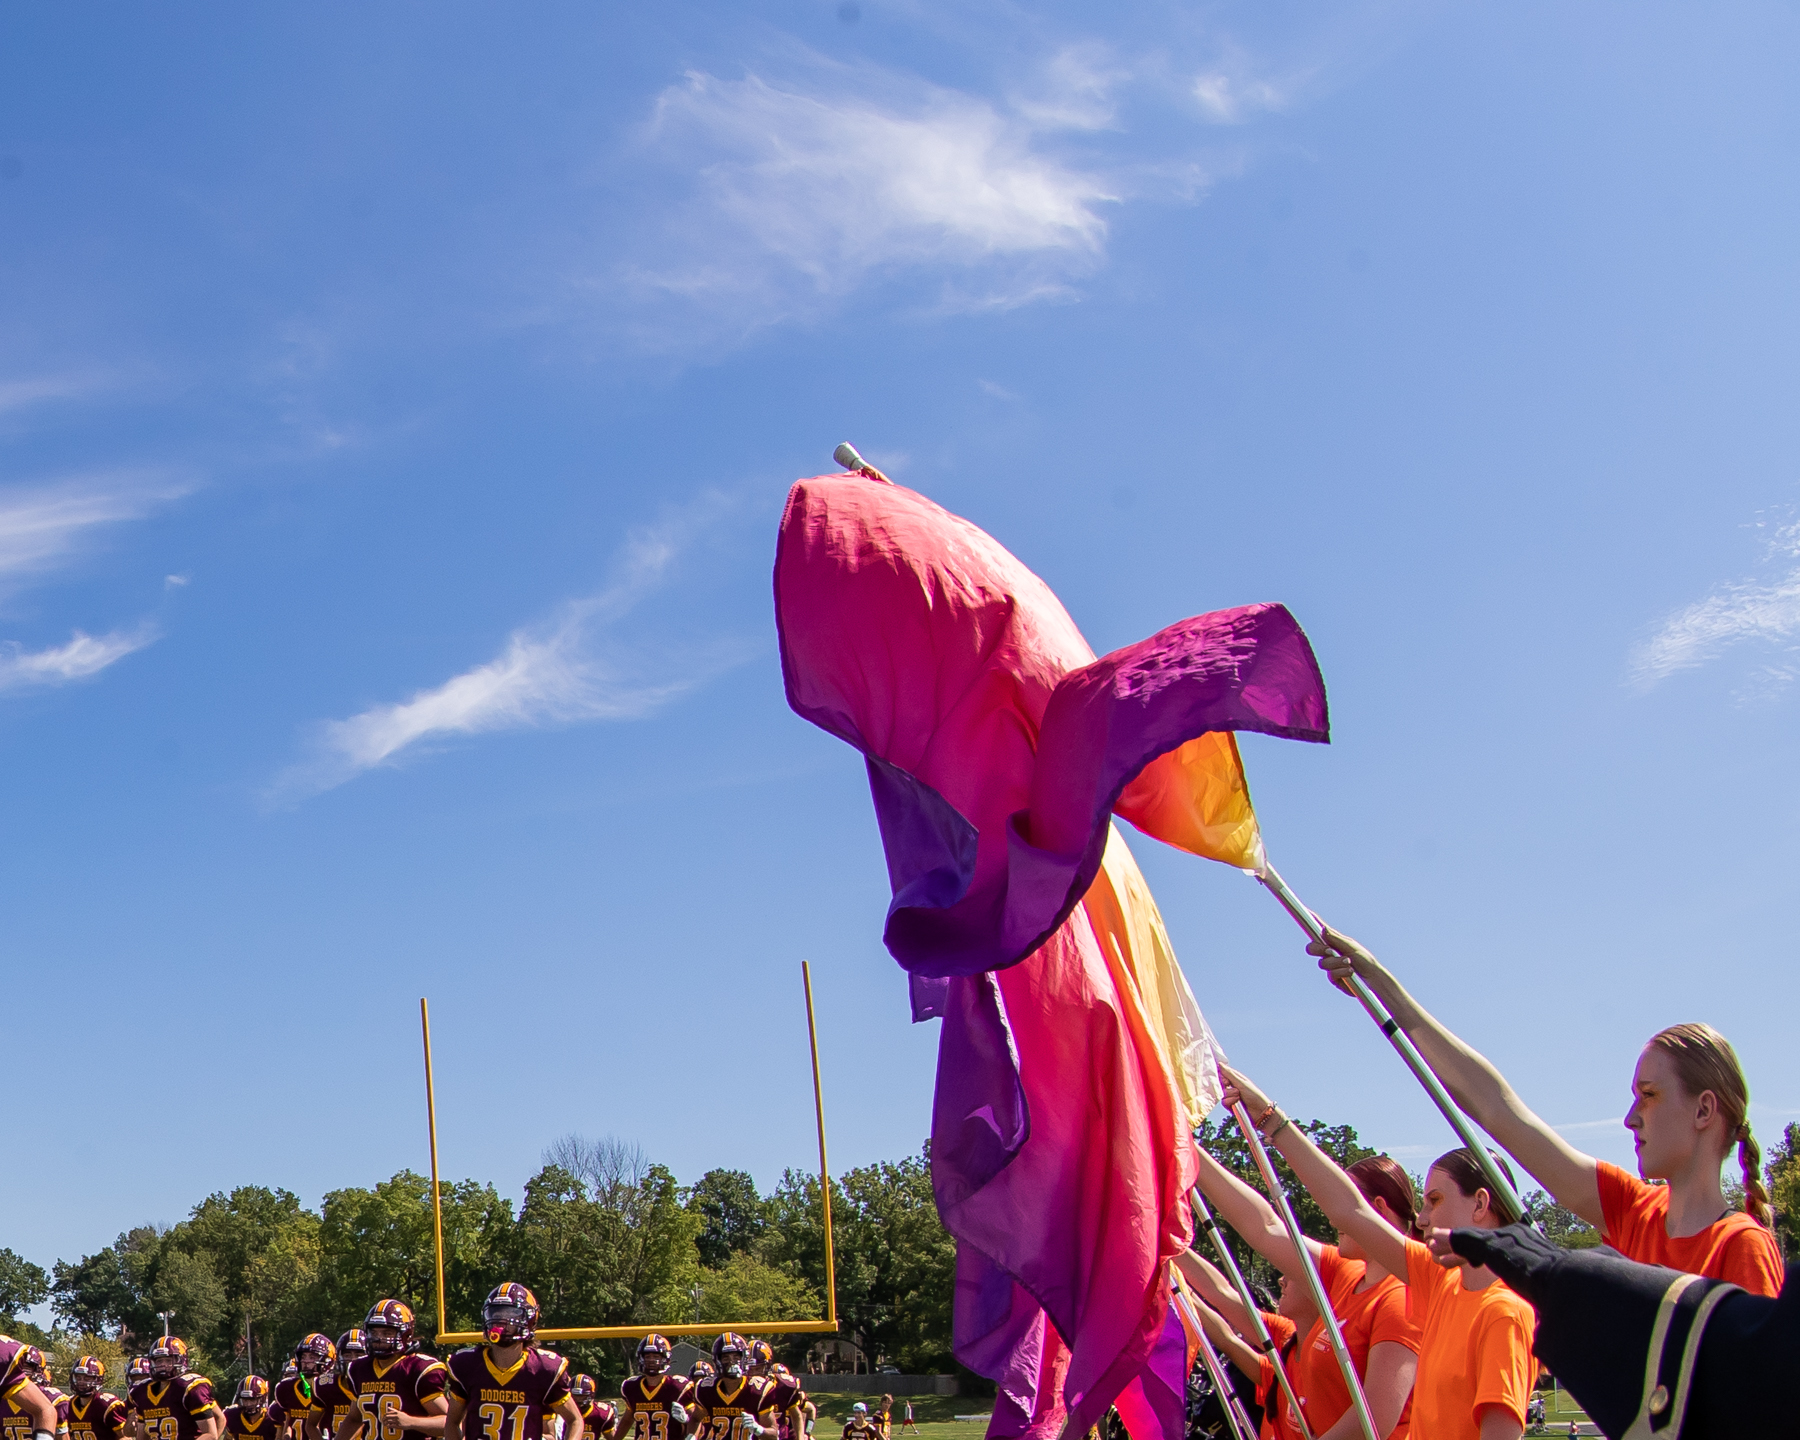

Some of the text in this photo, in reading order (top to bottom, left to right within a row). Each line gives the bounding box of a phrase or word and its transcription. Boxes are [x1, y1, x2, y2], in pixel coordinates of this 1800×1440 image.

[361, 1382, 395, 1393] DODGERS
[480, 1389, 525, 1404] DODGERS
[334, 1405, 351, 1416] DOD
